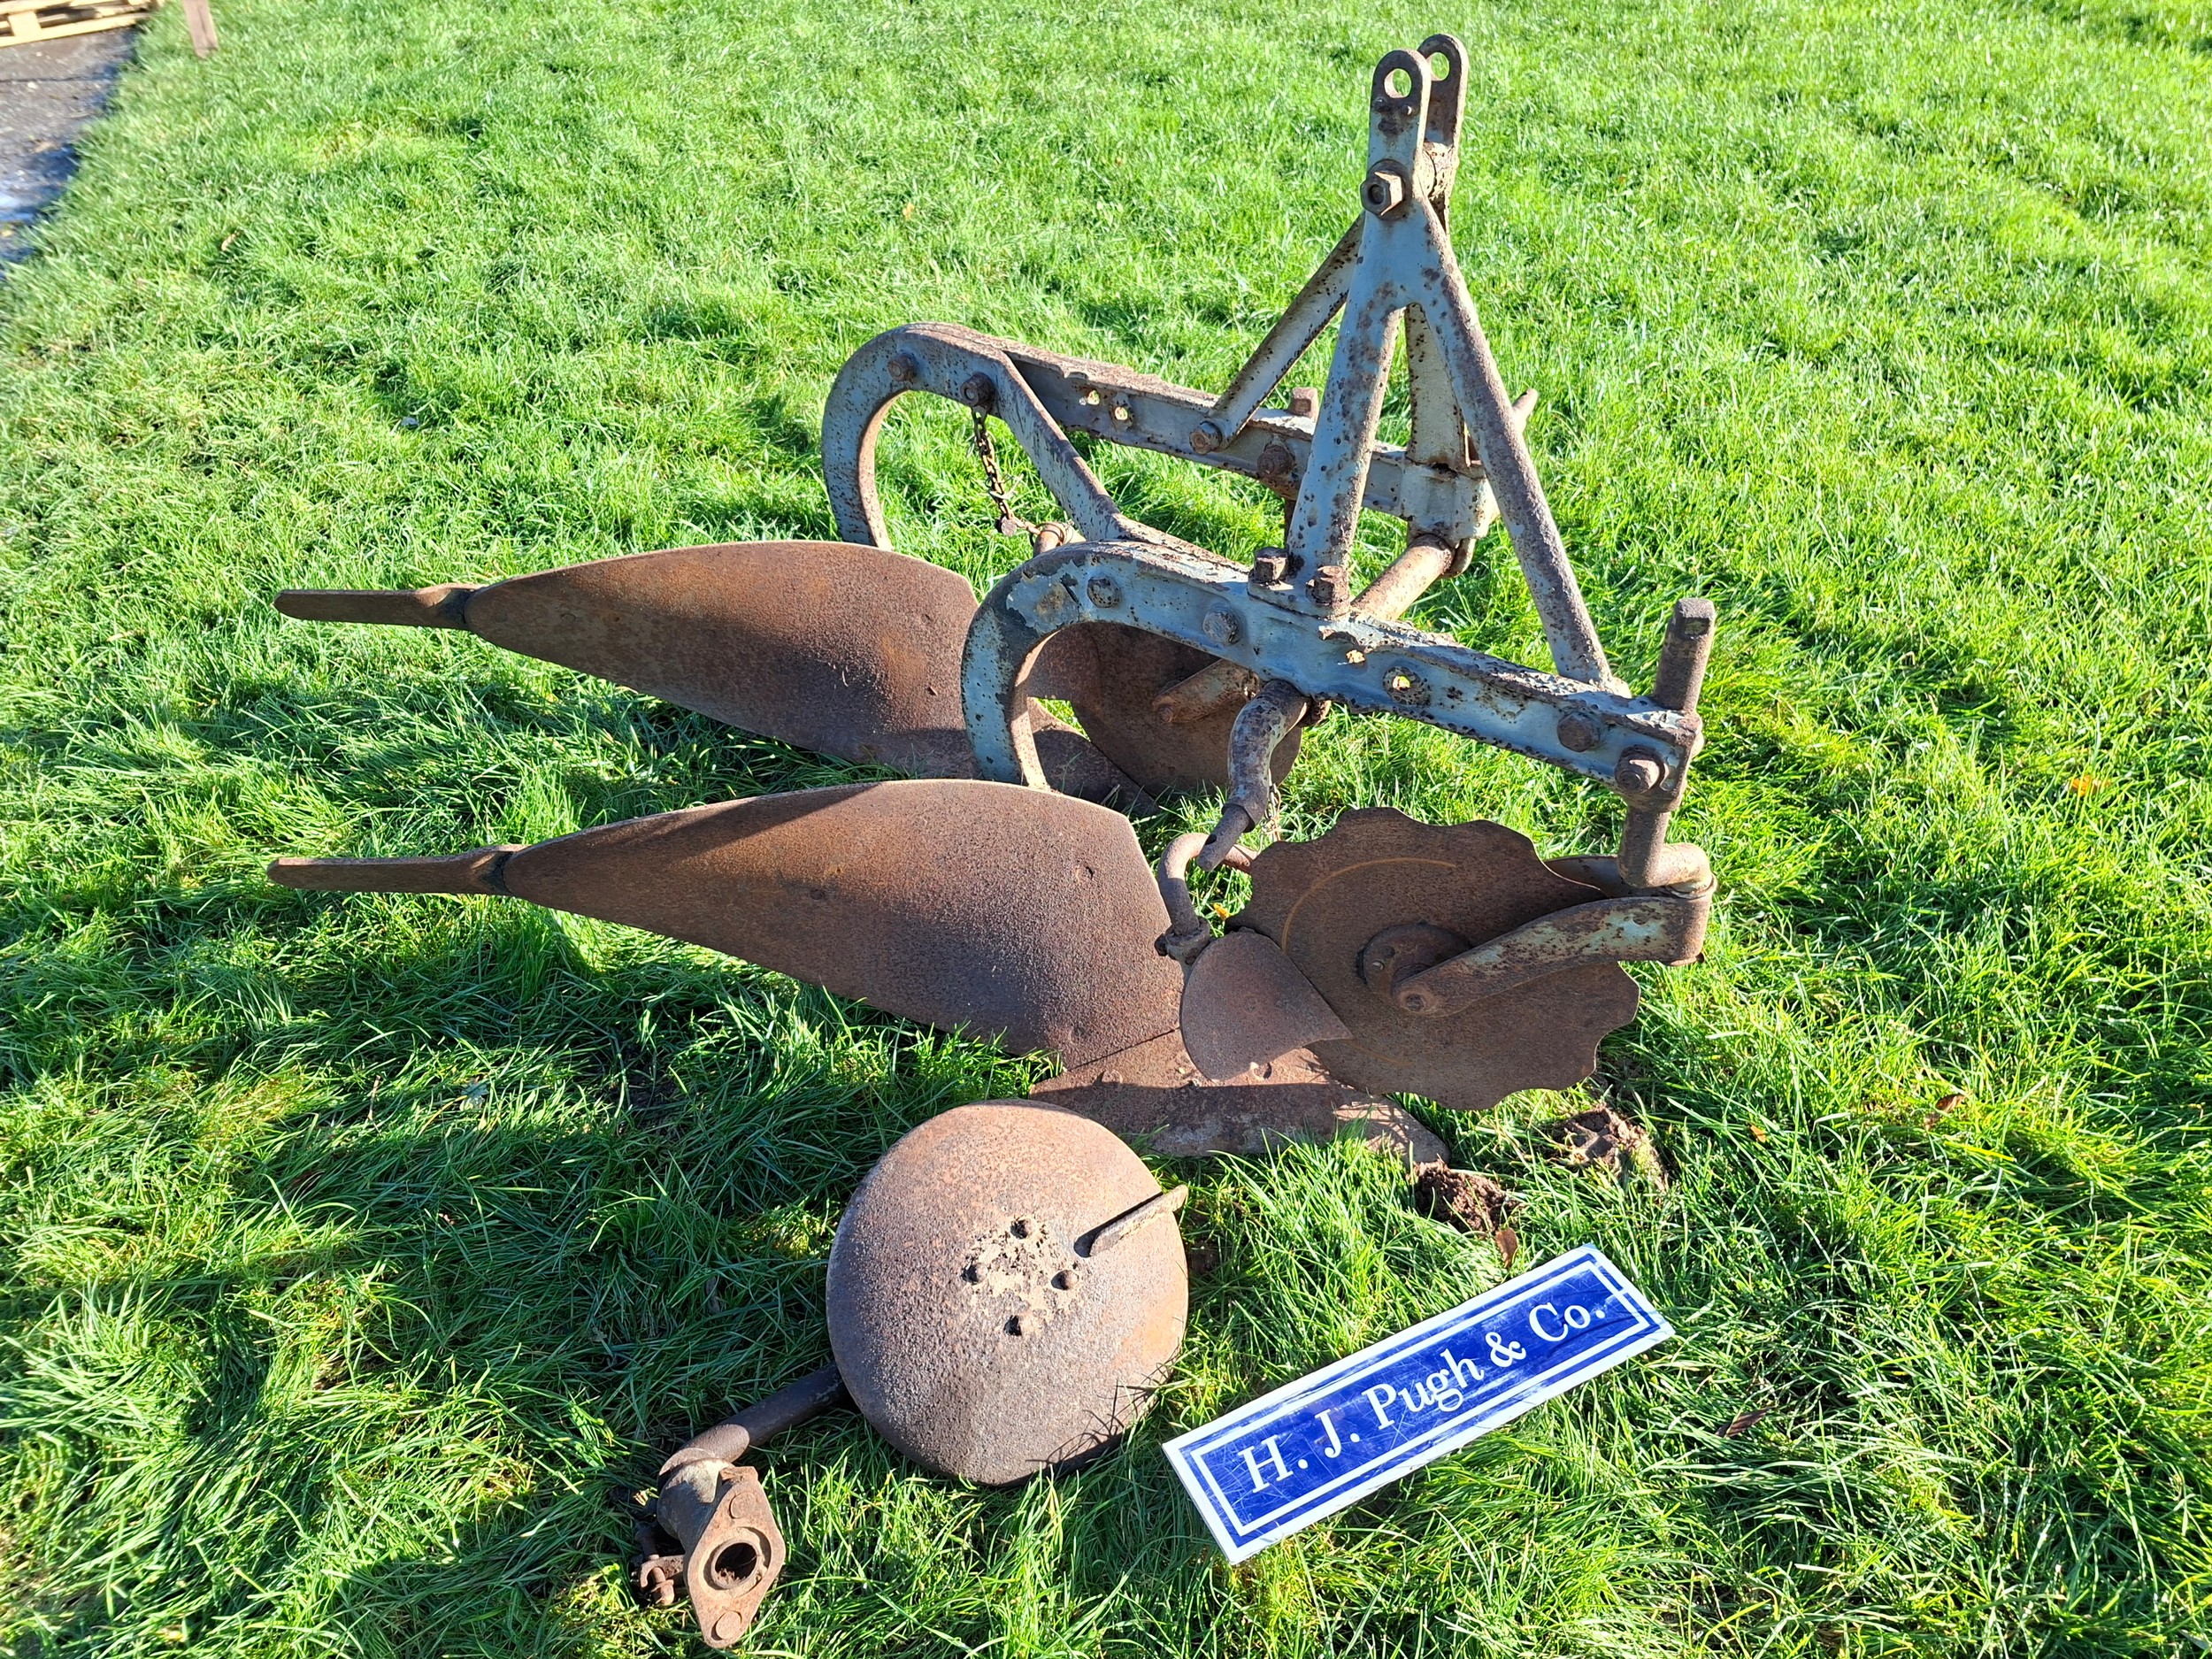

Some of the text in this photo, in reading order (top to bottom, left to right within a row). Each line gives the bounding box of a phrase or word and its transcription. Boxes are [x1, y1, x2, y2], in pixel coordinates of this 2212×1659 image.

[1238, 1301, 1606, 1494] H. J. Pugh & Co.
